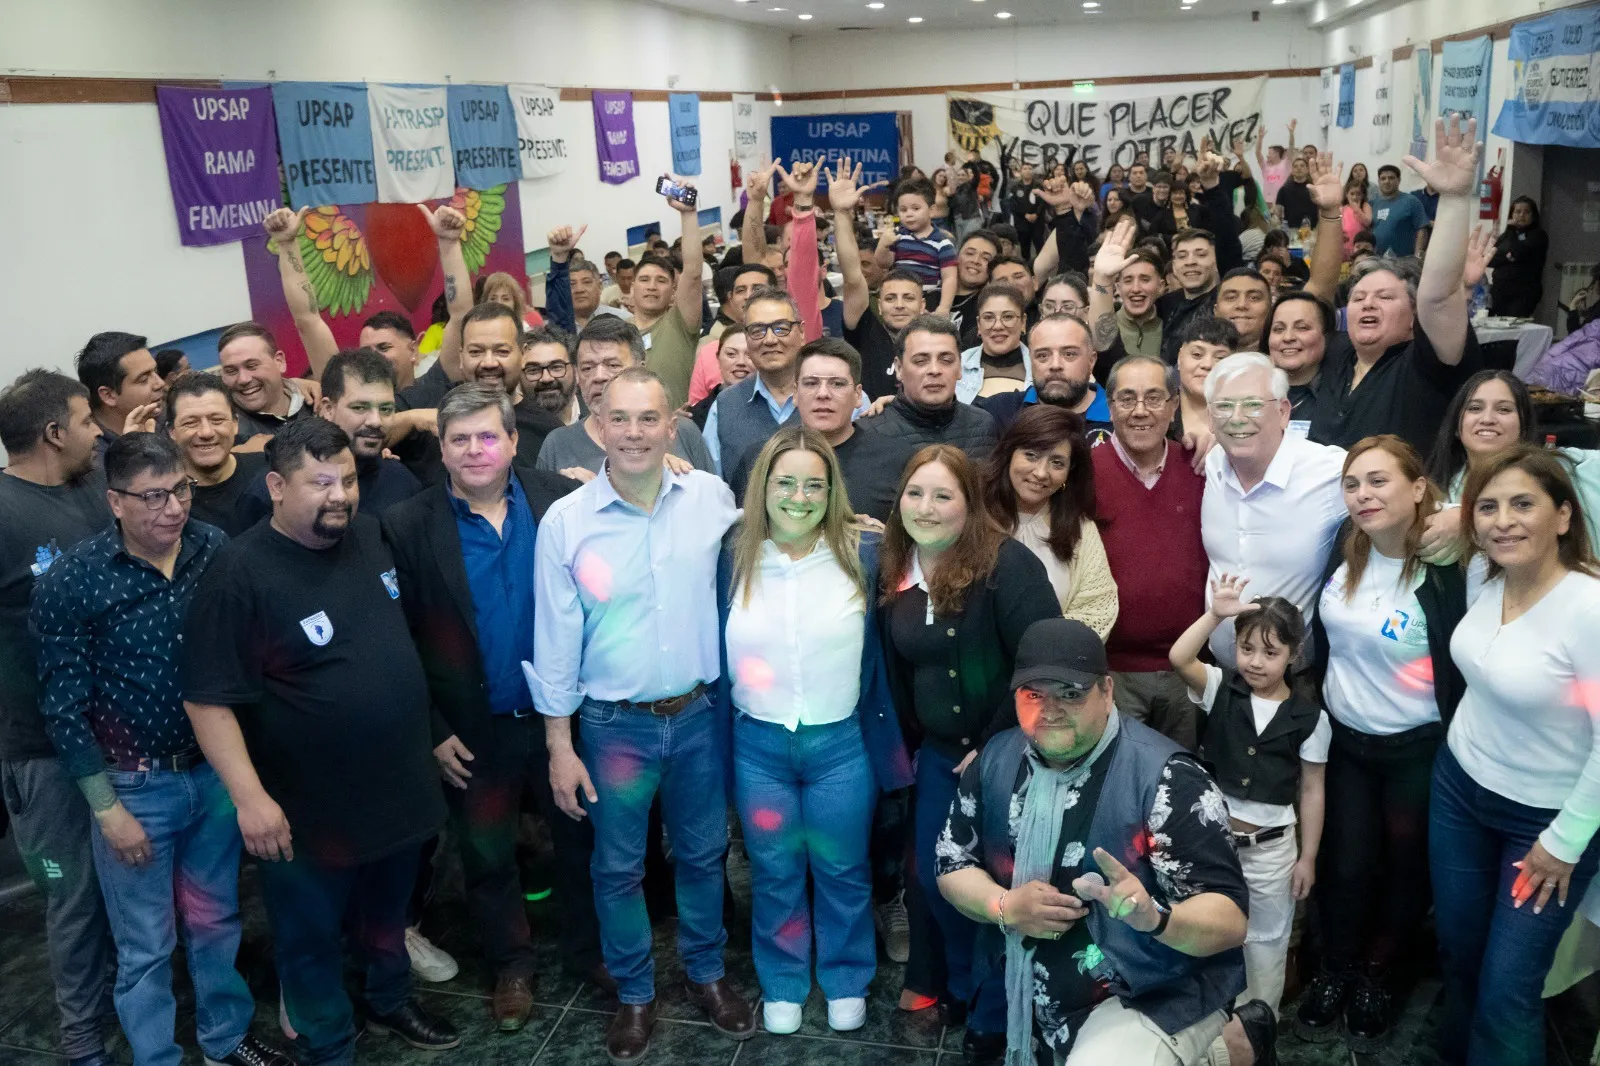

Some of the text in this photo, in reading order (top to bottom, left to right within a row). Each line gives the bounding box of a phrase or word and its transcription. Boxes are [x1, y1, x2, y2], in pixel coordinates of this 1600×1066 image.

[1551, 66, 1589, 89] GUTIERREZ
[193, 97, 250, 121] UPSAP
[297, 99, 354, 128] UPSAP
[461, 99, 499, 122] UPSAP
[520, 96, 554, 116] UPSAP
[1027, 99, 1099, 137] QUE
[1109, 87, 1232, 137] PLACER
[808, 122, 871, 138] UPSAP
[518, 137, 567, 160] PRESENT
[1114, 130, 1199, 172] OTRA
[1209, 112, 1260, 152] VEZ
[204, 149, 255, 175] RAMA
[386, 146, 446, 172] PRESENT
[456, 146, 517, 172] PRESENTE
[789, 147, 891, 164] ARGENTINA
[1411, 618, 1427, 630] UPS
